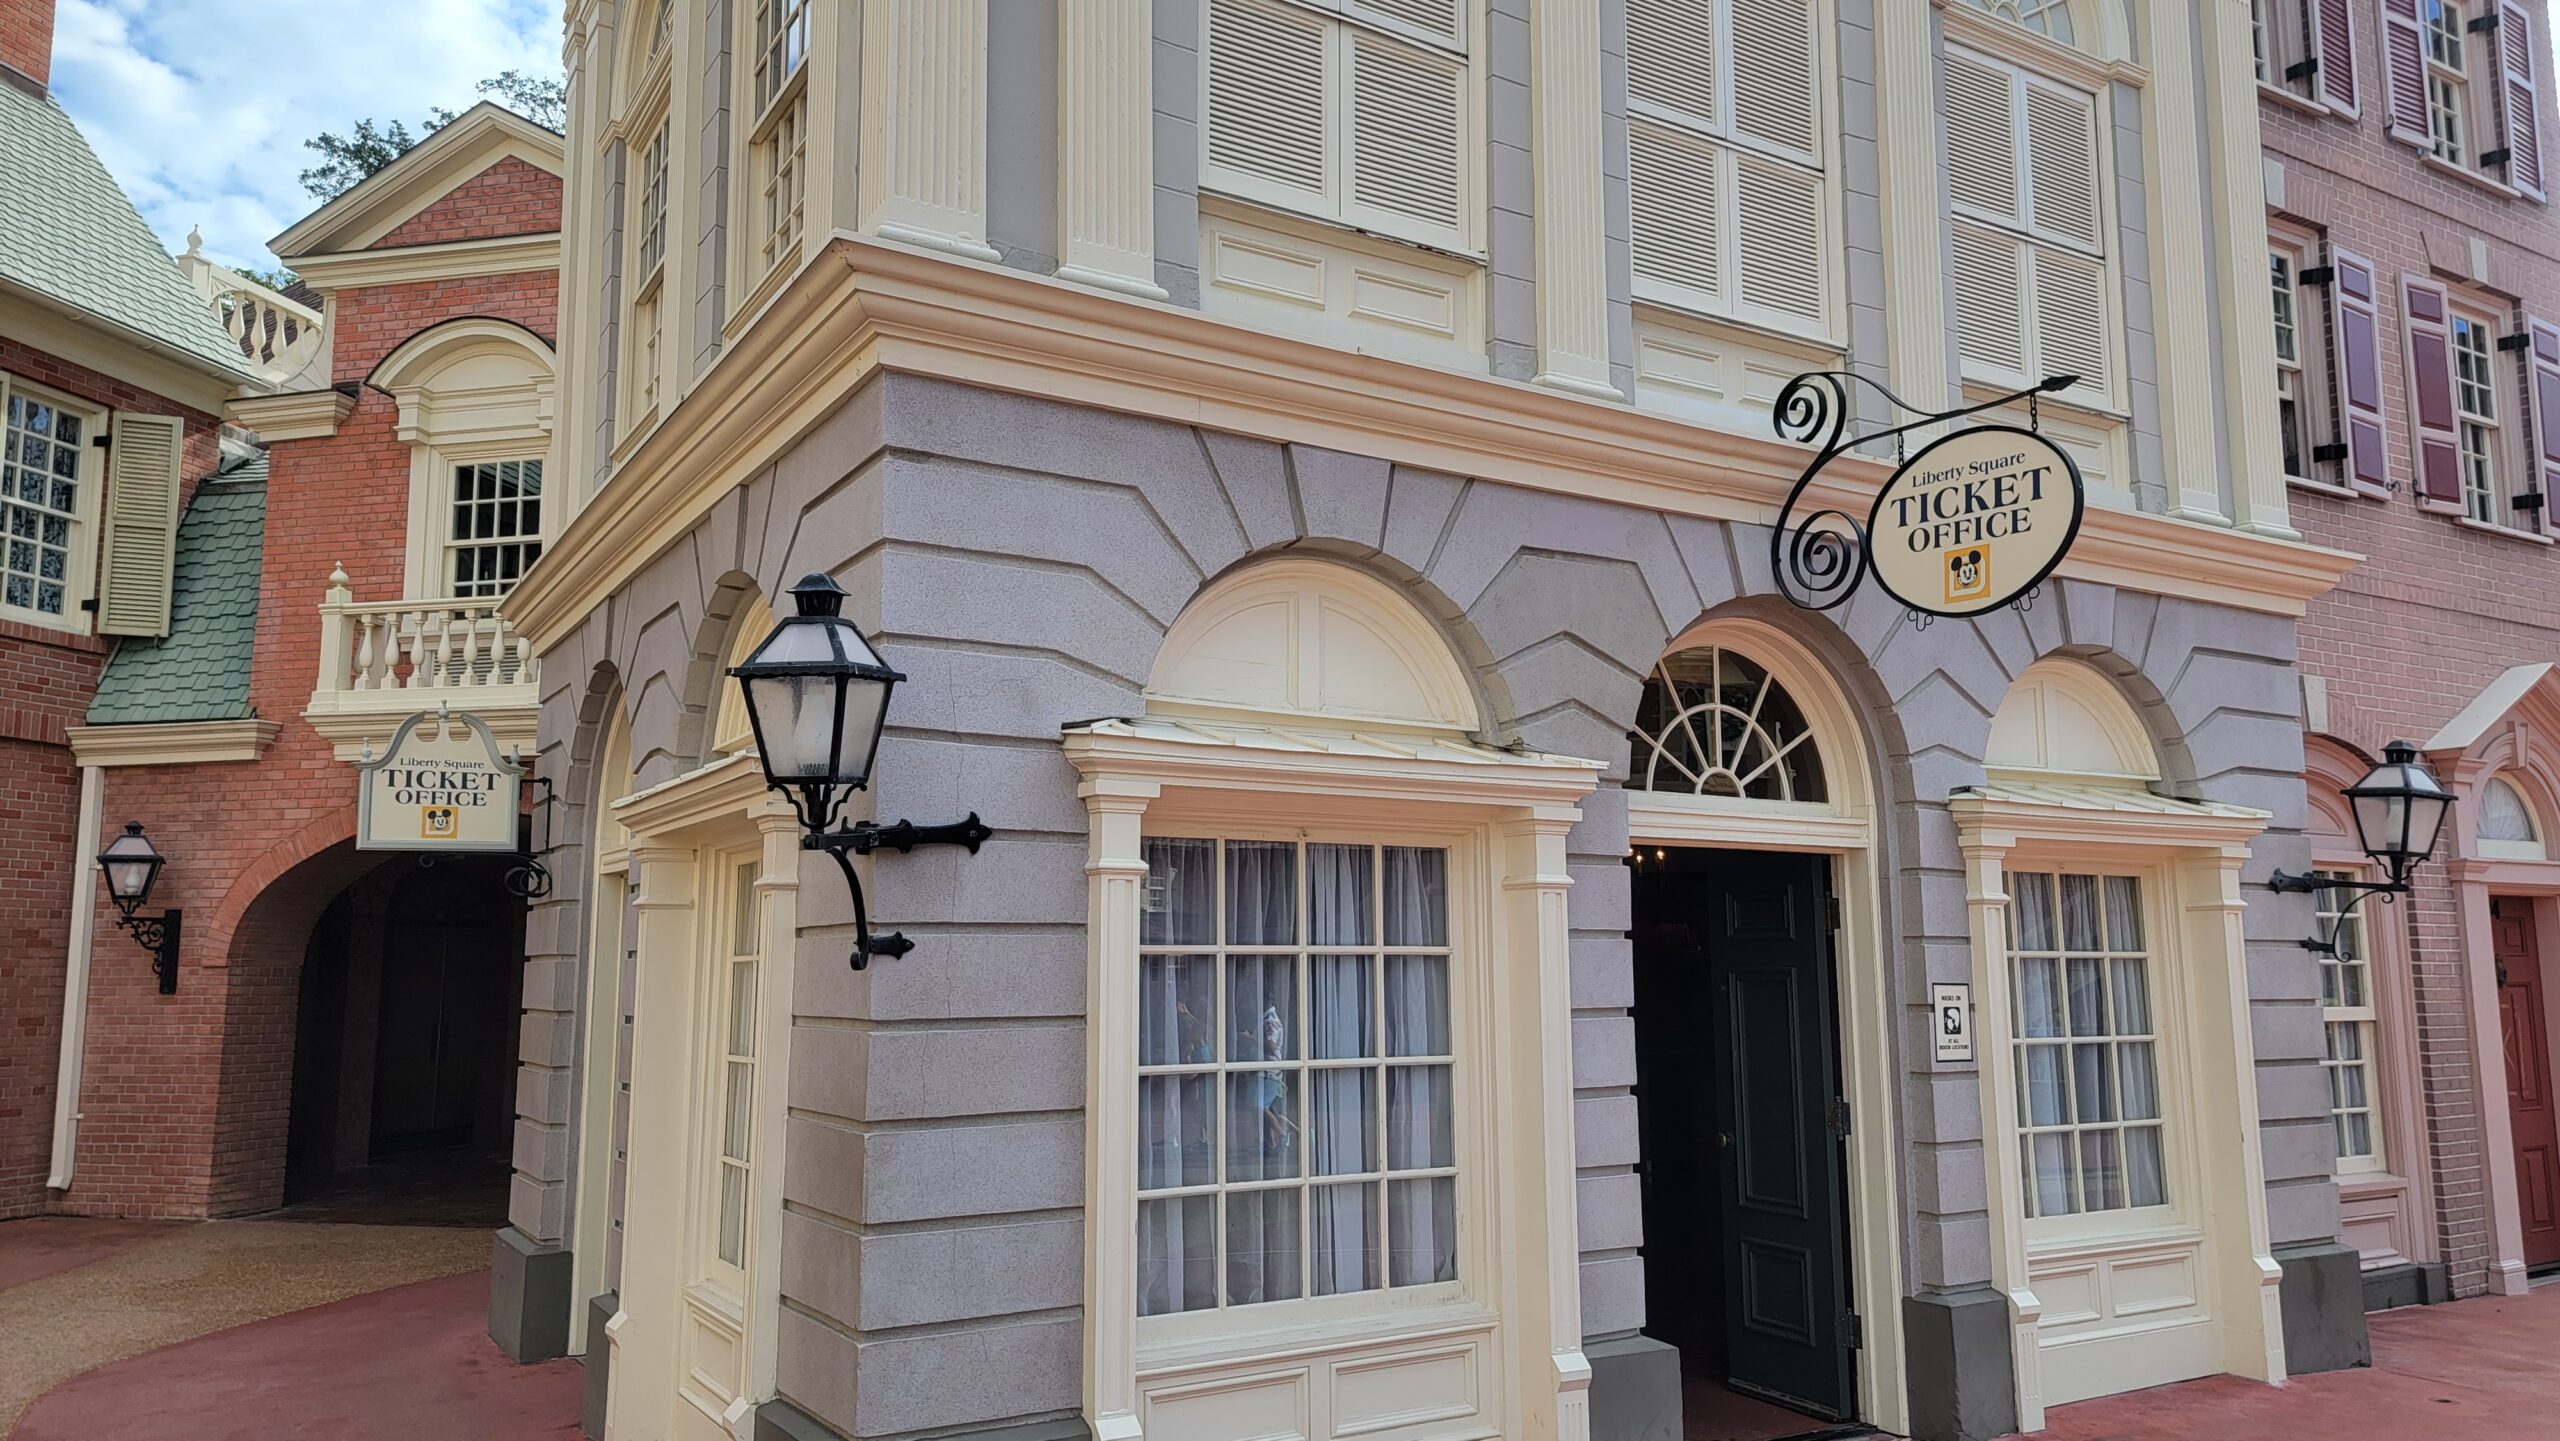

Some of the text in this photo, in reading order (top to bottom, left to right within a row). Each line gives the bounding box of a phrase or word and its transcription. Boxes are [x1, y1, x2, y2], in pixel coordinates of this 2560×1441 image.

[1912, 452, 2026, 488] Liberty Square
[1890, 466, 2052, 528] TICKET
[1908, 507, 2032, 552] OFFICE
[400, 757, 485, 770] Liberty Square
[382, 769, 501, 791] TICKET
[395, 790, 487, 806] OFFICE
